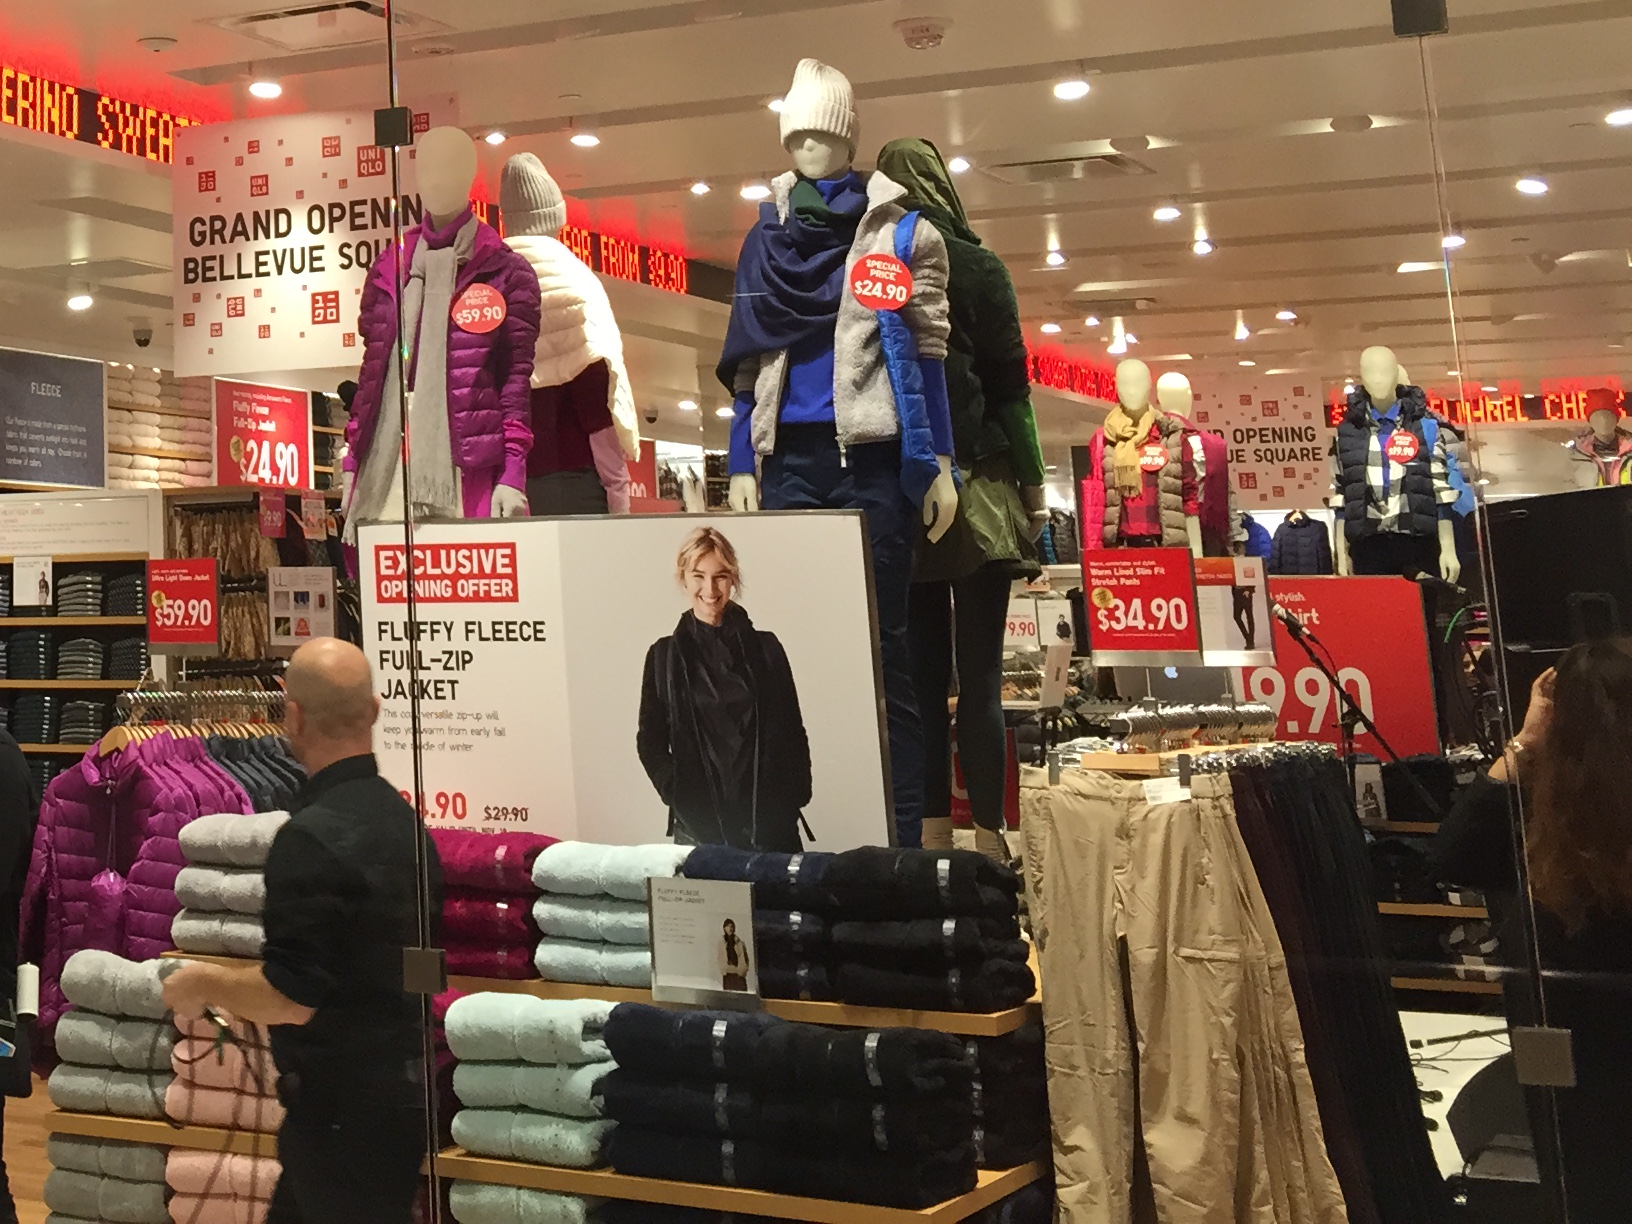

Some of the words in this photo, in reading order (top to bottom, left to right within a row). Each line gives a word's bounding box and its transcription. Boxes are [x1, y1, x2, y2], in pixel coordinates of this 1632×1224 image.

[97, 96, 201, 165] SWEA
[188, 207, 293, 247] GRAND
[307, 193, 423, 236] OPENN
[184, 244, 326, 285] BELLEVUE
[338, 238, 392, 270] SQU
[600, 235, 641, 284] FROM
[866, 259, 902, 274] SPECIAL
[870, 269, 897, 281] PRICE
[854, 280, 907, 302] $24.90
[456, 306, 502, 325] $59.90
[1233, 426, 1316, 445] OPENING
[240, 439, 298, 486] $24.90
[1254, 447, 1323, 465] SQUARE
[457, 578, 513, 597] OFFER
[1275, 591, 1307, 603] stylish.
[155, 598, 212, 627] $59.90
[1097, 597, 1188, 632] $34.90
[464, 620, 546, 642] FLEECE
[1005, 621, 1036, 637] 9.90
[379, 649, 474, 671] FULL-ZIP
[381, 678, 459, 701] JACKET
[457, 710, 482, 722] zip-up
[448, 725, 468, 736] from
[470, 727, 490, 738] early
[483, 805, 529, 822] $29.90
